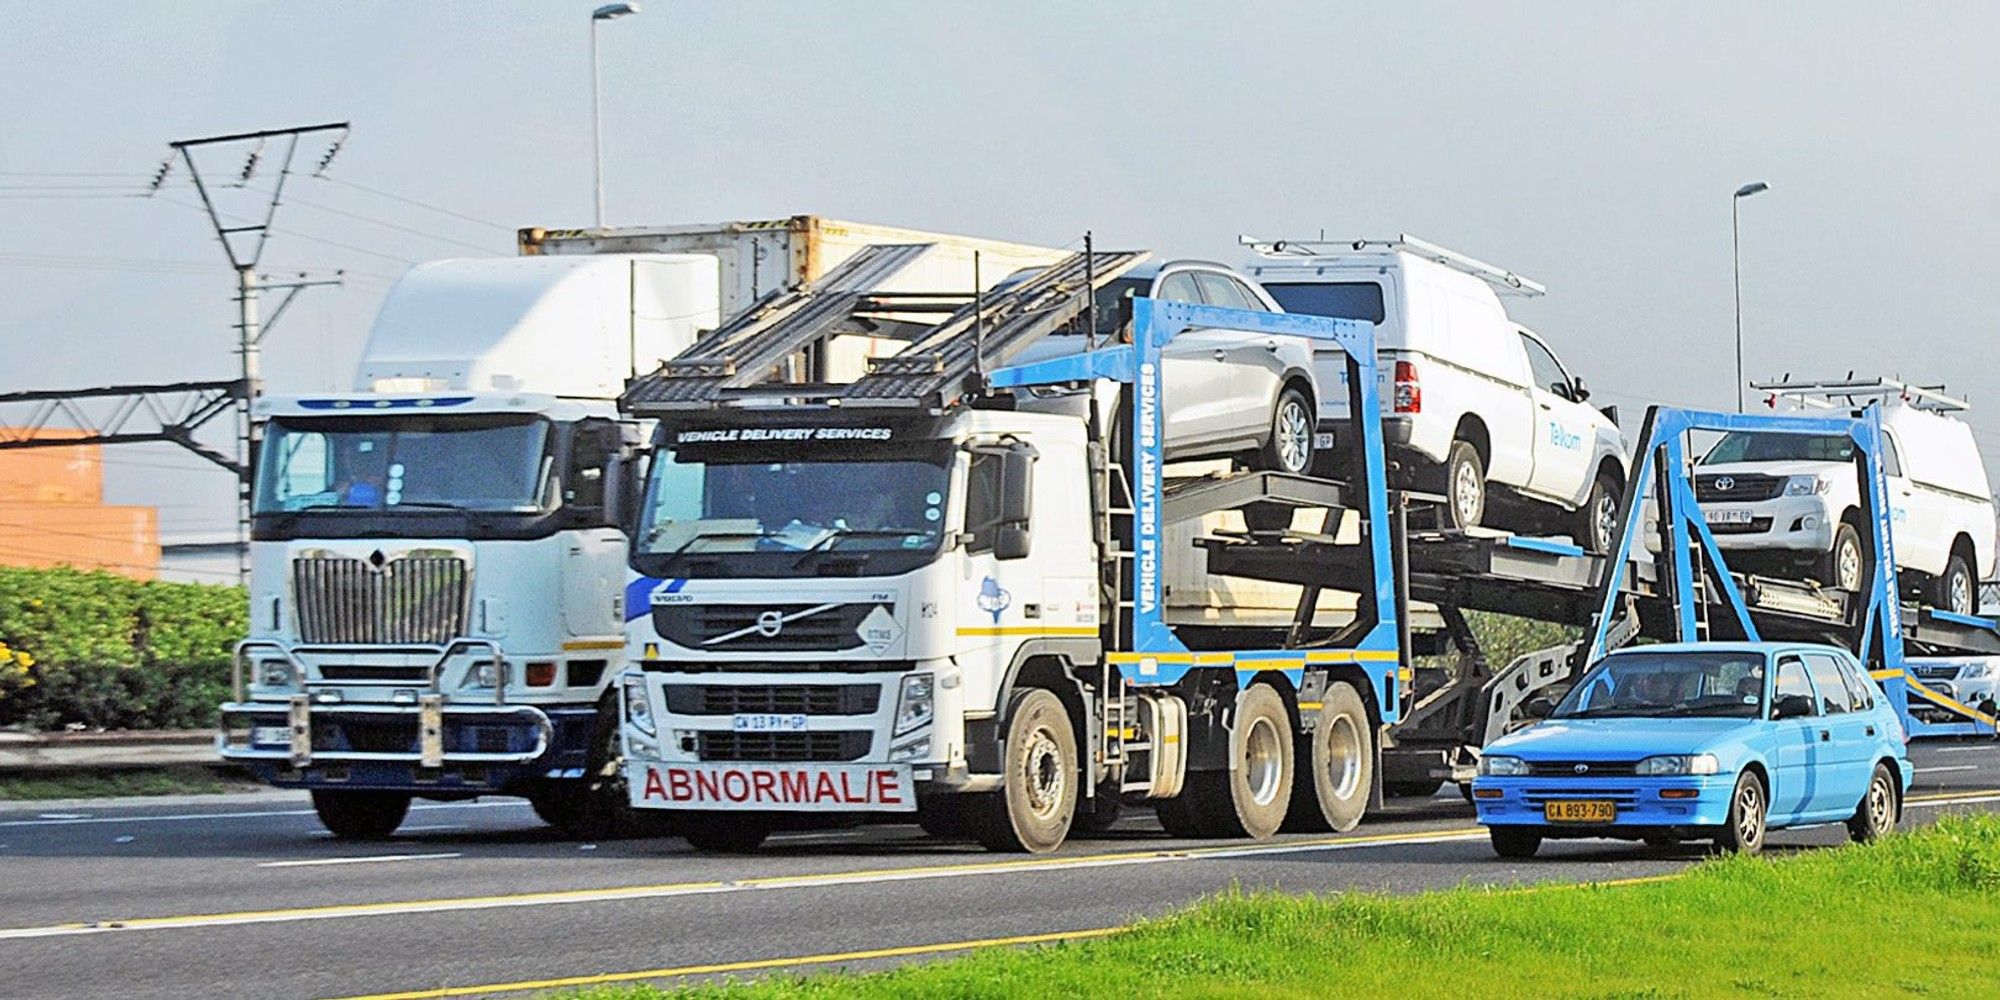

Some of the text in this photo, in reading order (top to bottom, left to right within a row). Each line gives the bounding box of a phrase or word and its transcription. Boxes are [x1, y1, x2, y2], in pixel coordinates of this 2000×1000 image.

[678, 428, 892, 443] VEHICLE DELIVERY SERVICES
[1549, 421, 1582, 452] Telkom
[1140, 363, 1156, 614] VEHICLE DELIVERY SERVICES
[654, 594, 694, 602] VOLVO
[1548, 802, 1613, 819] CA 893-790
